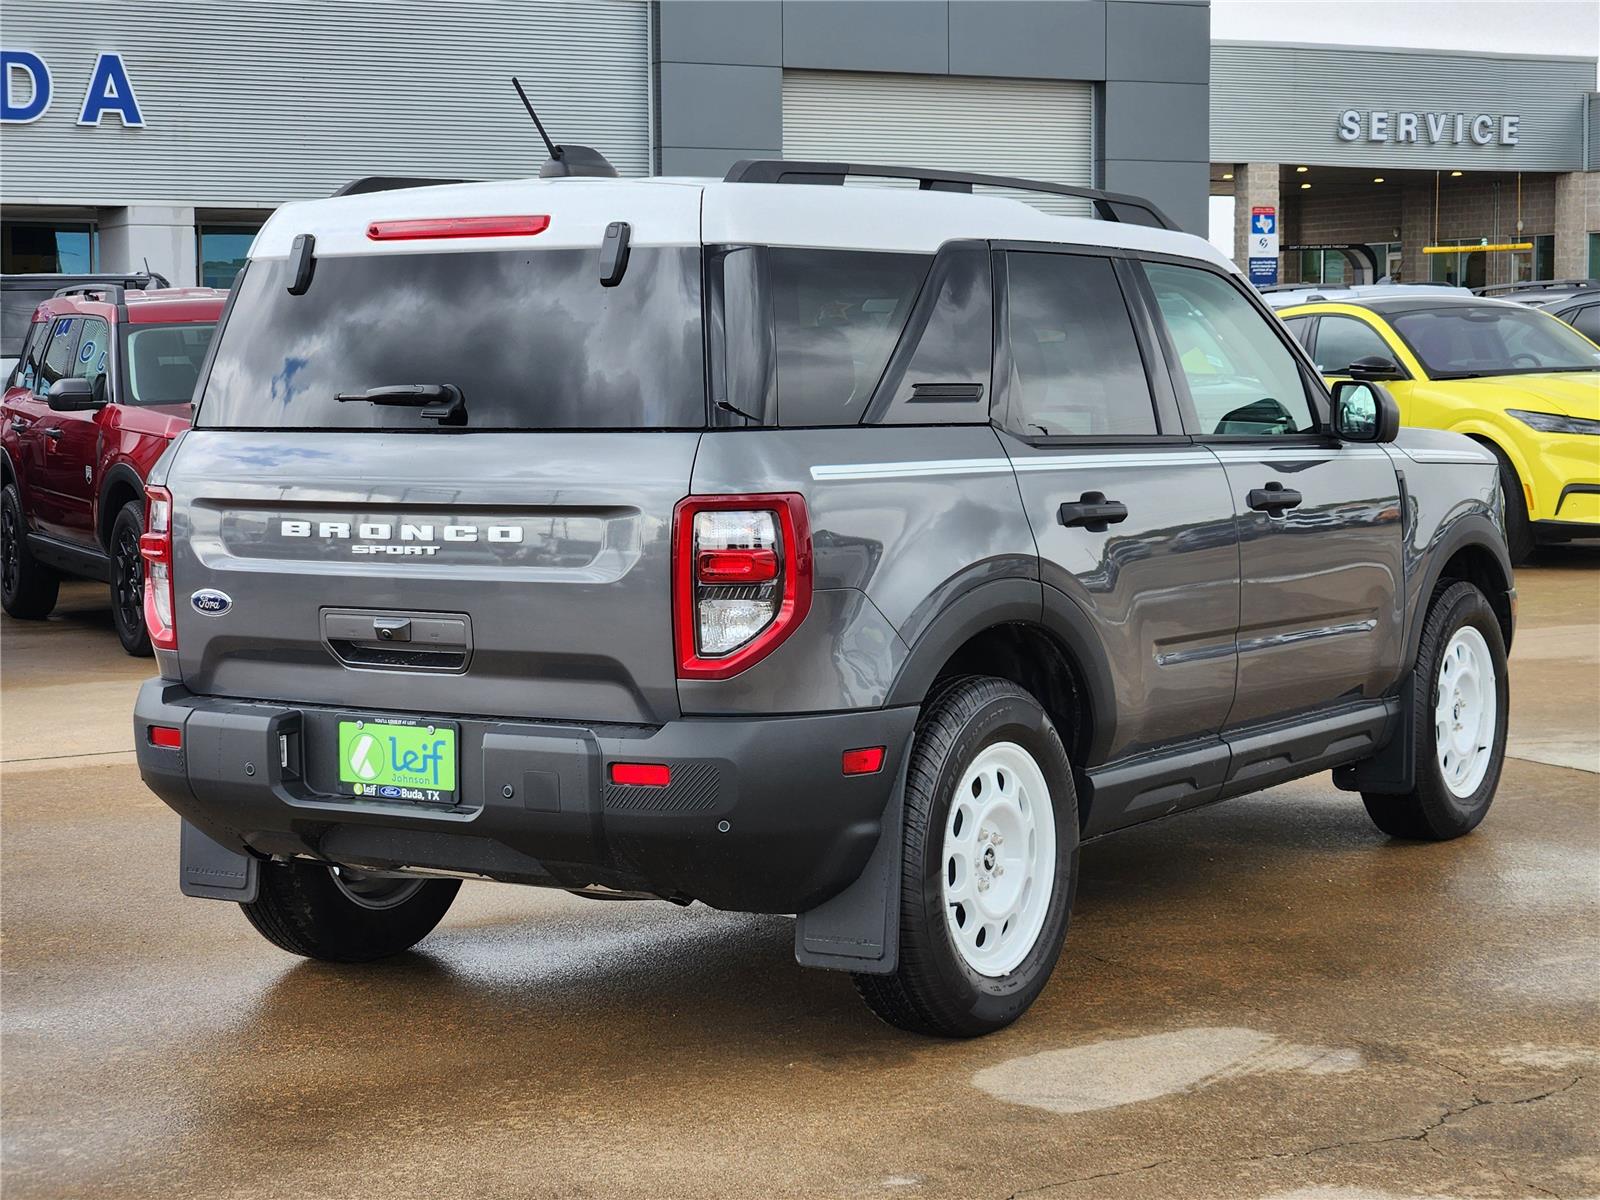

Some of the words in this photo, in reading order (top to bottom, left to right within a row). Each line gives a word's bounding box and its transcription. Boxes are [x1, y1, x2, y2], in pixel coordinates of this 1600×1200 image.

[1338, 109, 1520, 146] SERVICE
[281, 520, 524, 544] BRONCO
[351, 544, 441, 555] SPORT
[391, 774, 430, 785] Johnson
[401, 788, 425, 800] Buda,
[426, 791, 440, 800] TX
